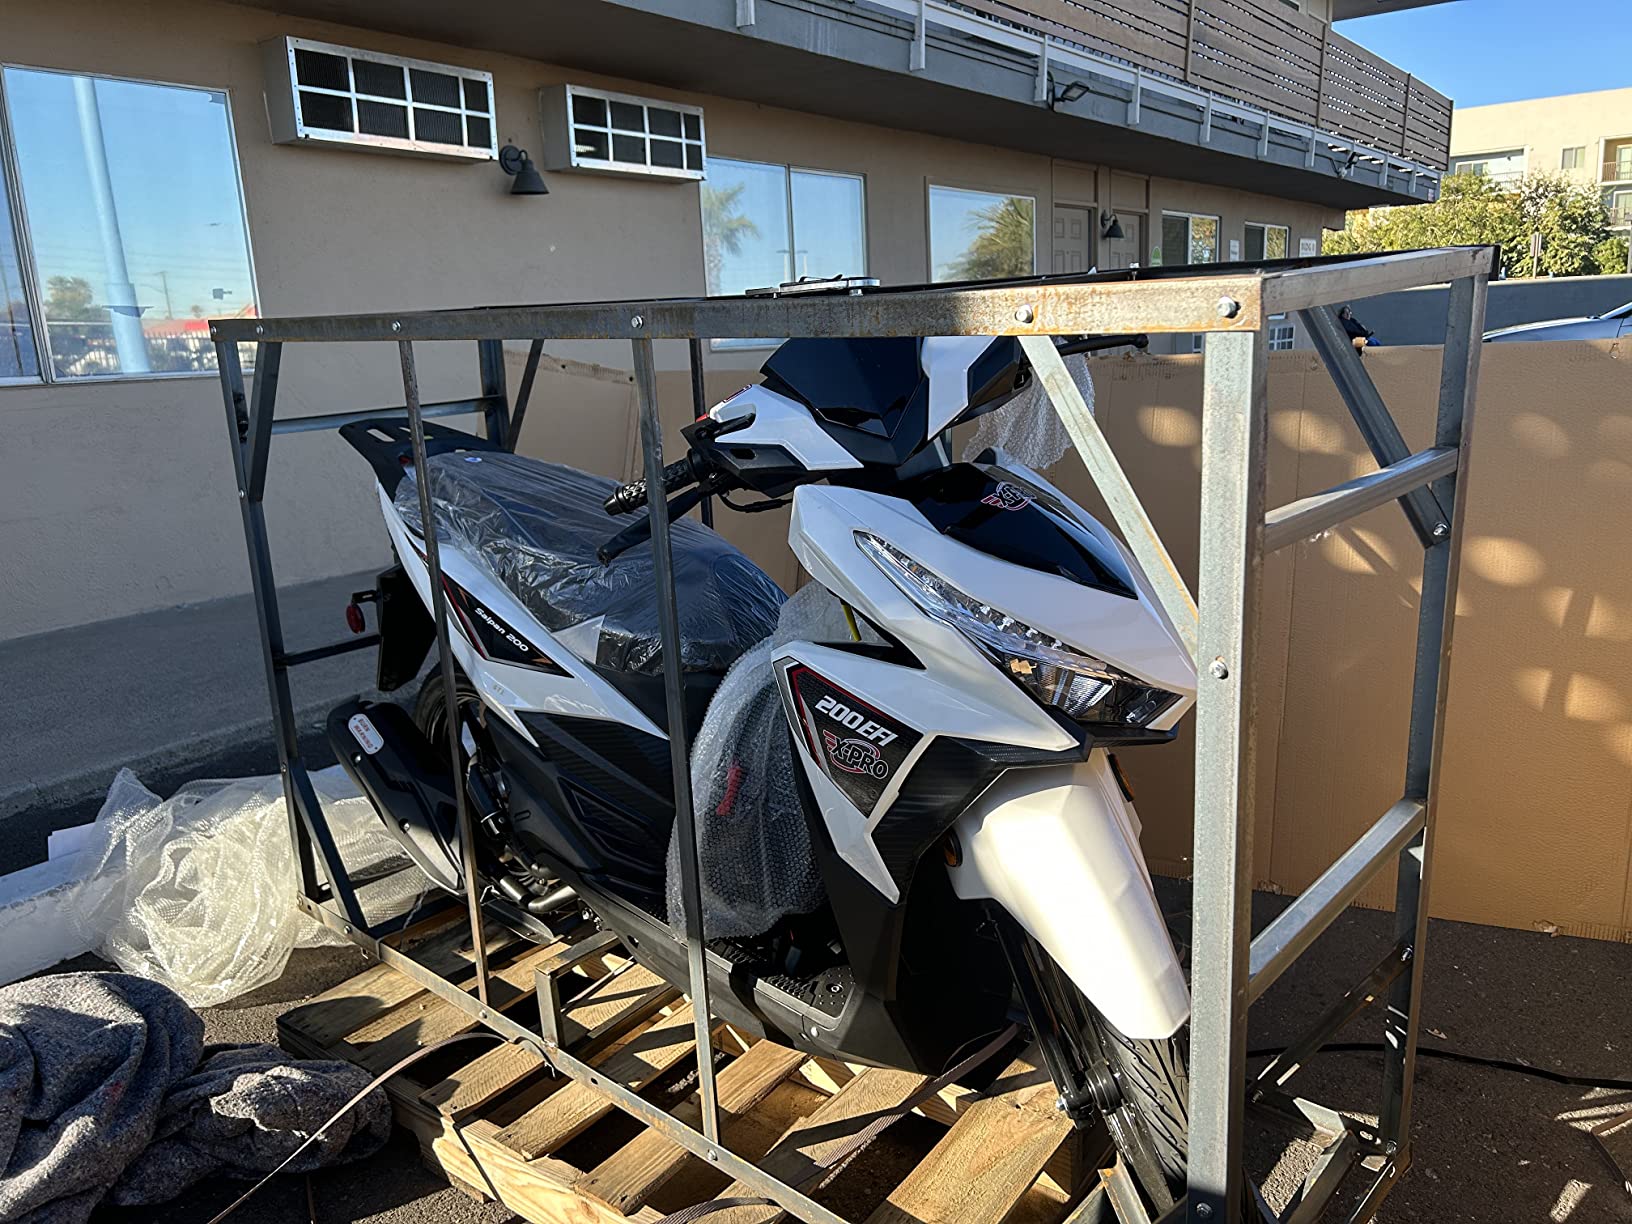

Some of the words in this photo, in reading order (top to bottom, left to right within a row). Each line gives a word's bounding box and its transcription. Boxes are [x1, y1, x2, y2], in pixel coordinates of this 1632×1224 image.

[474, 607, 506, 635] Saipan
[505, 633, 529, 652] 200
[830, 736, 889, 779] X-PRO
